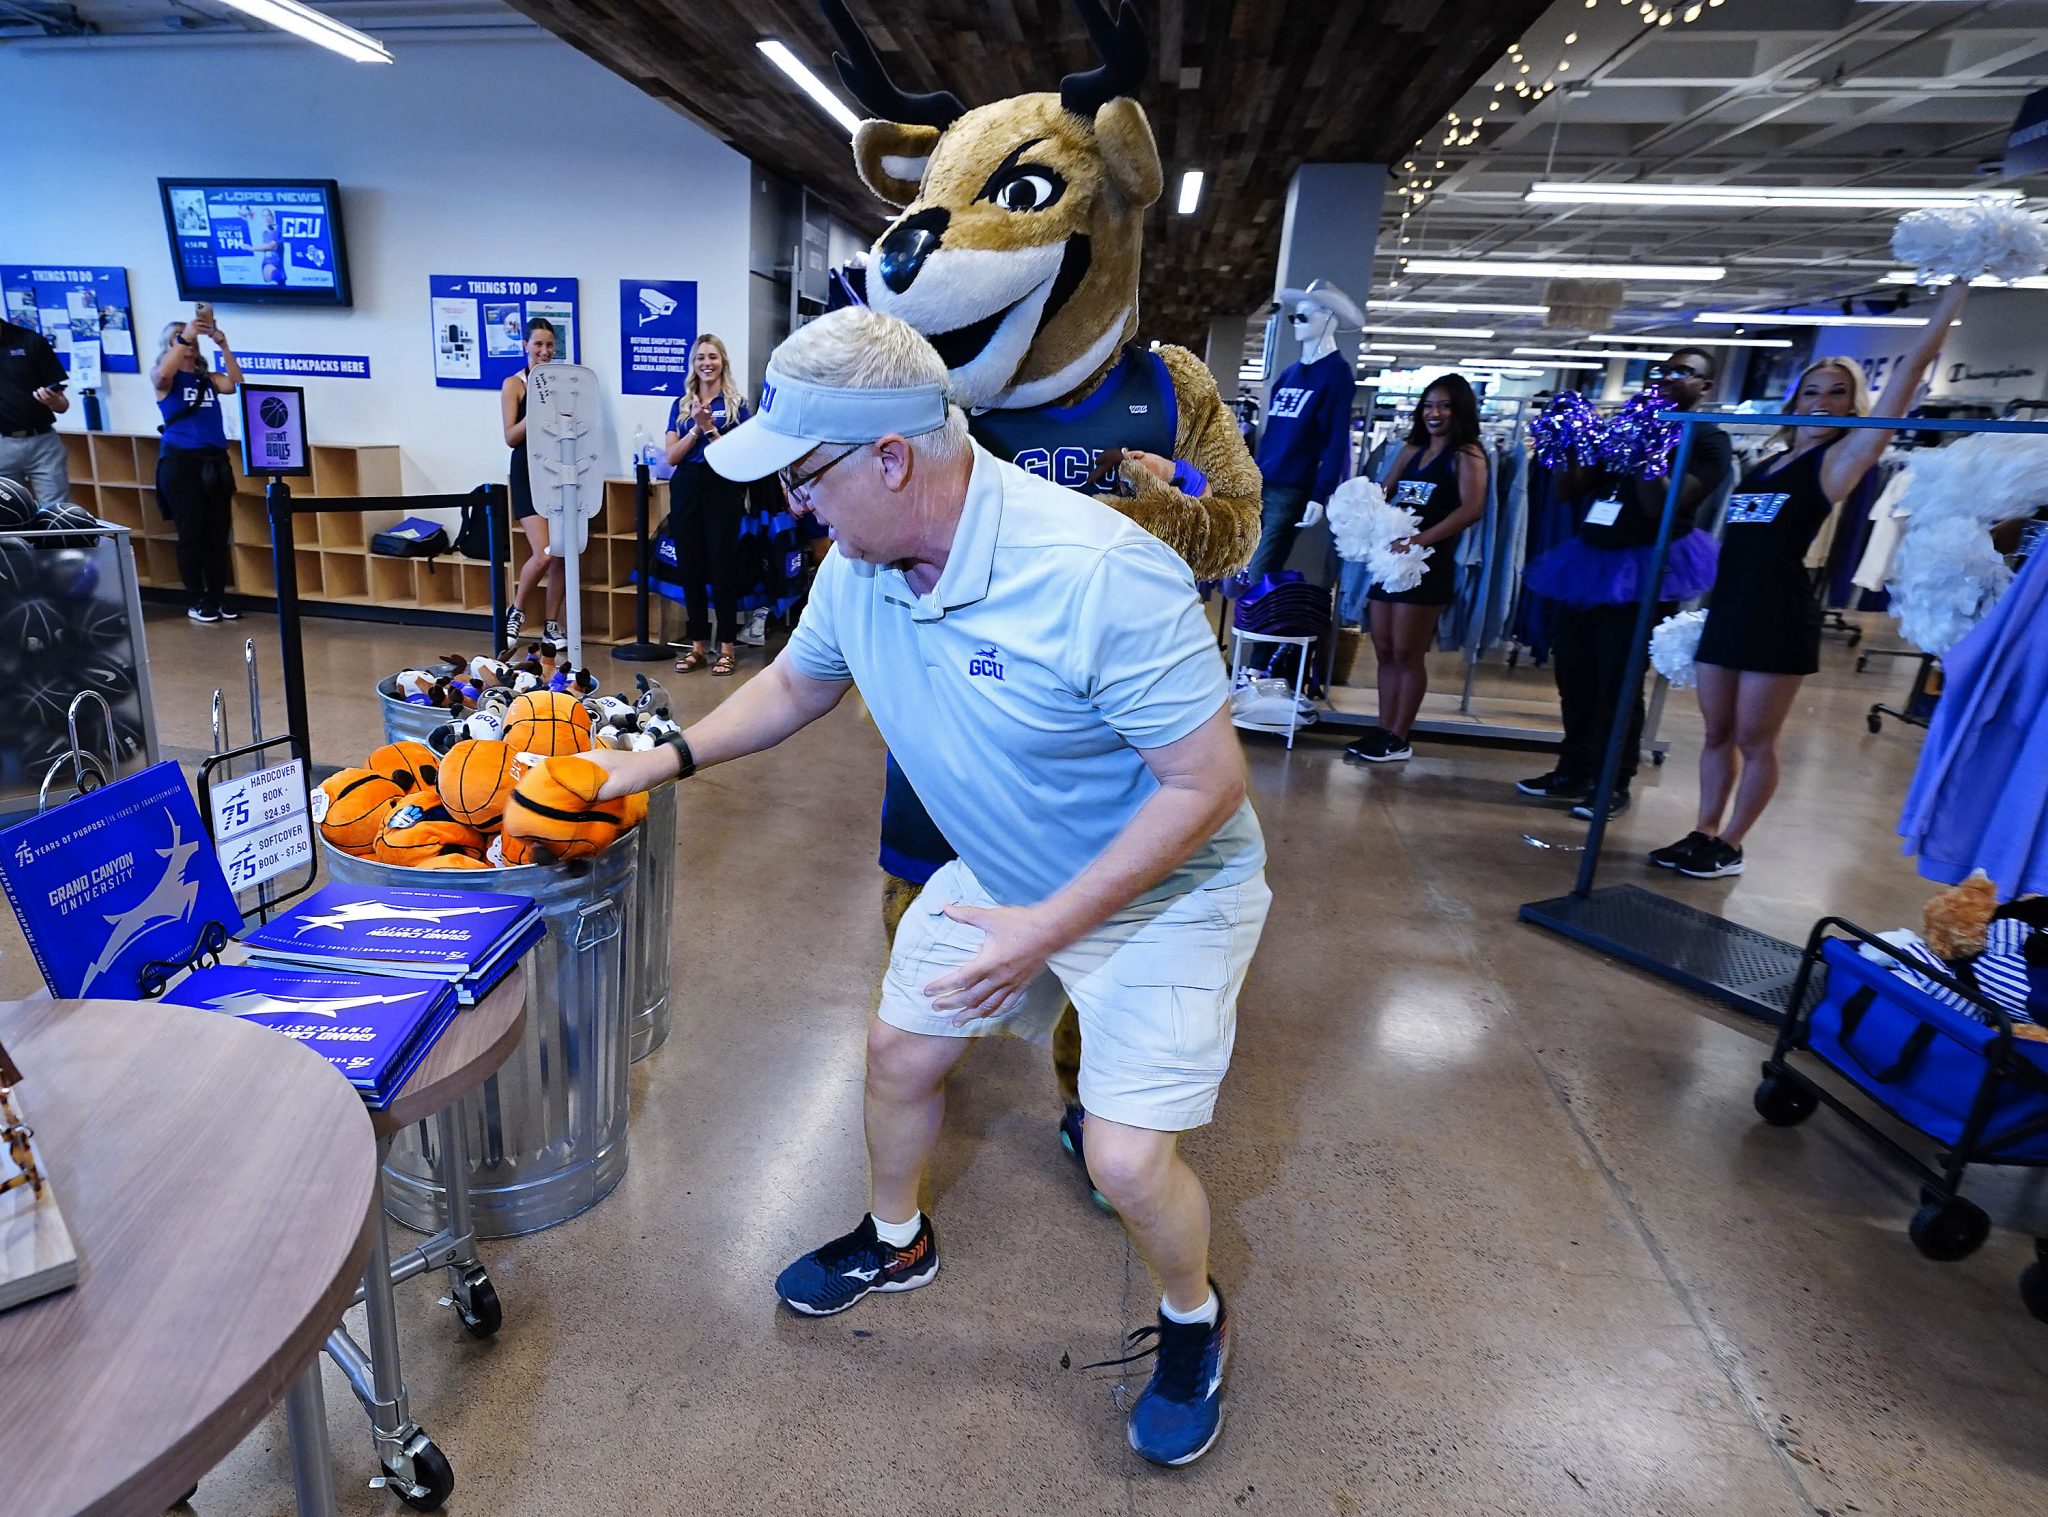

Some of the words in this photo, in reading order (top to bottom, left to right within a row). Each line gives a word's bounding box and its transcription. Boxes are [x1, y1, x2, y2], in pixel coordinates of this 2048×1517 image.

[225, 192, 274, 202] LOPES
[276, 192, 321, 203] NEWS
[282, 217, 321, 238] GCU
[227, 239, 244, 249] PM
[32, 270, 66, 282] THINGS
[66, 270, 79, 282] TO
[80, 271, 93, 282] DO
[468, 281, 507, 295] THINGS
[508, 282, 521, 295] TO
[523, 282, 538, 295] DO
[630, 336, 650, 345] BEFORE
[653, 346, 670, 354] SHOW
[670, 347, 685, 355] YOUR
[220, 356, 254, 369] PASE
[254, 357, 283, 370] LEAVE
[284, 358, 340, 372] BACKPACKS
[340, 360, 365, 373] HERE
[647, 355, 658, 363] THE
[658, 356, 685, 364] SECURITY
[655, 364, 667, 372] AND
[969, 659, 1005, 681] GCU
[475, 714, 497, 728] GCU
[250, 764, 296, 788] HARDCOVER
[262, 787, 284, 803] BOOK
[222, 800, 250, 831] 75
[264, 803, 291, 820] $24.99
[15, 847, 34, 868] 75
[34, 839, 61, 857] YEARS
[62, 834, 71, 844] OF
[73, 819, 106, 840] PURPOSE
[258, 824, 303, 850] SOFTCOVER
[258, 852, 280, 870] BOOK
[286, 841, 308, 857] $7.50
[229, 854, 256, 887] 75
[48, 874, 90, 907] GRAND
[91, 851, 135, 887] CANYON
[61, 867, 135, 916] UNIVERSITY
[16, 907, 35, 943] PURPOSE
[279, 1030, 317, 1040] CAN
[315, 1031, 377, 1042] GRAND
[347, 1056, 375, 1066] 75
